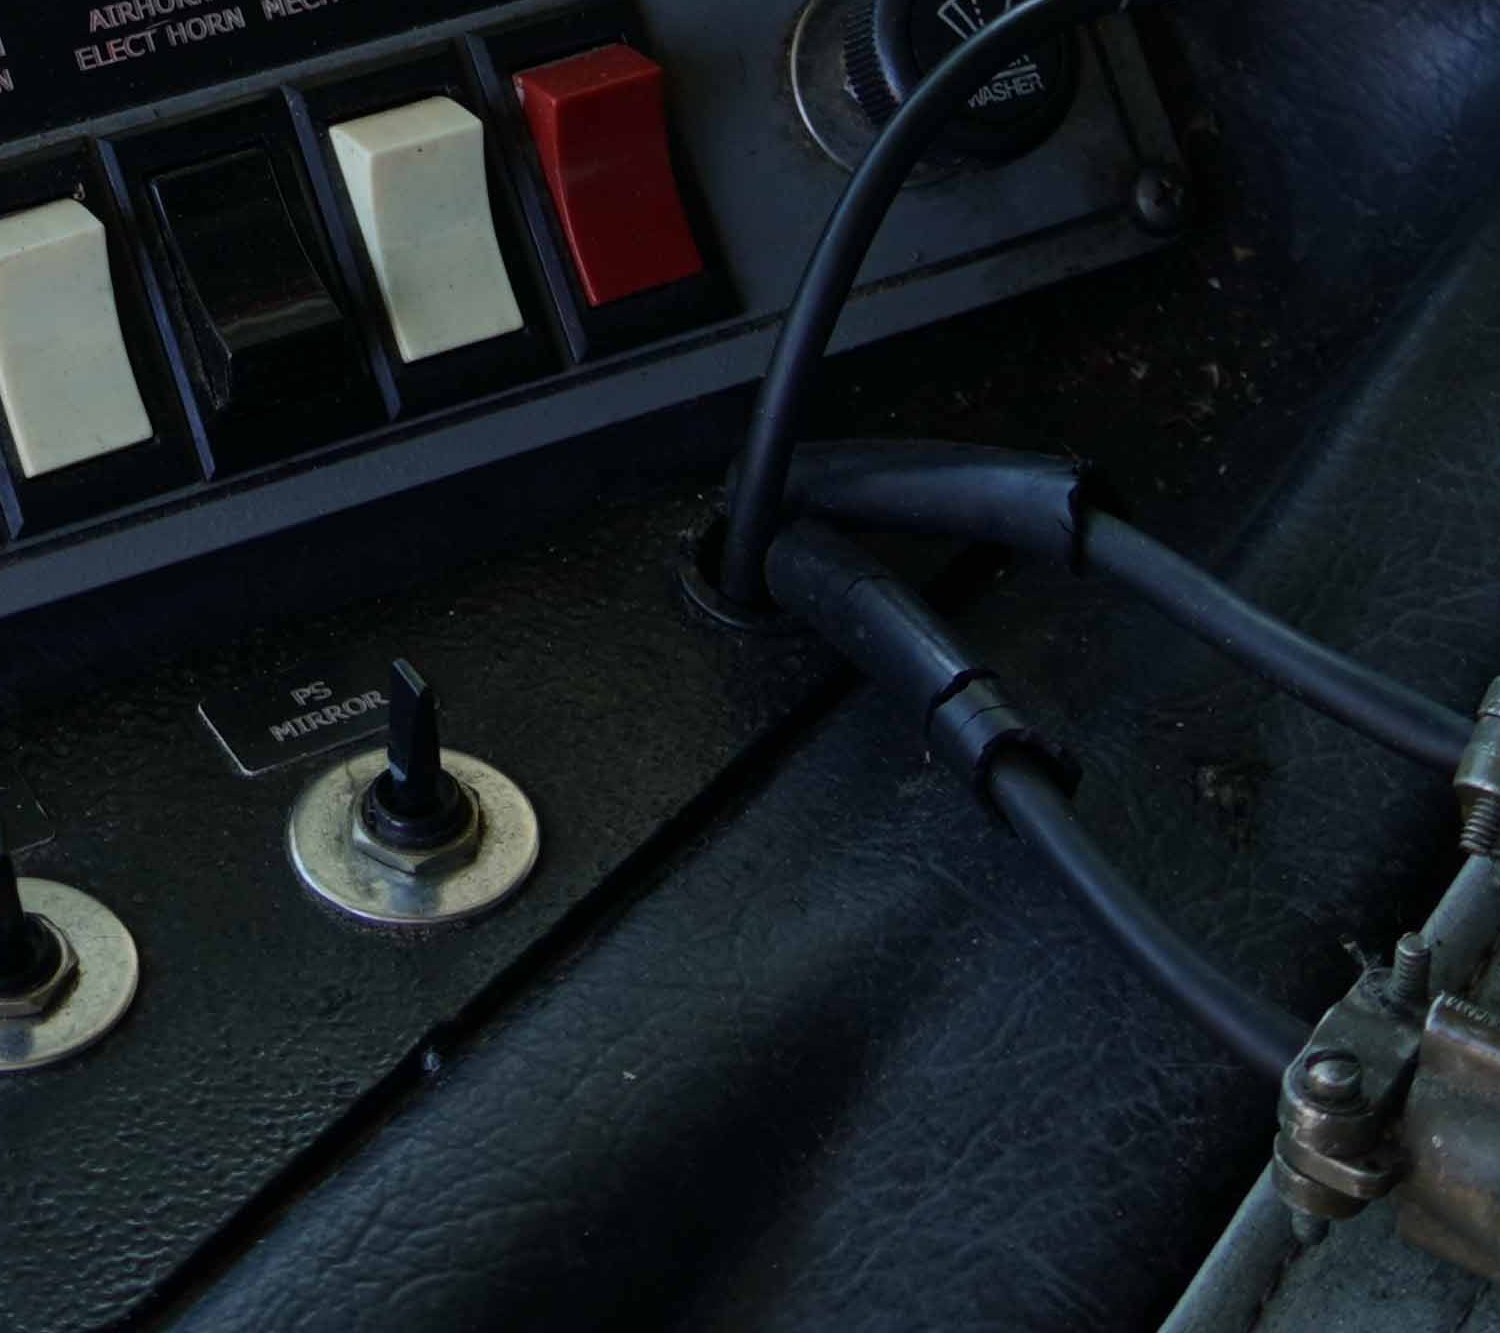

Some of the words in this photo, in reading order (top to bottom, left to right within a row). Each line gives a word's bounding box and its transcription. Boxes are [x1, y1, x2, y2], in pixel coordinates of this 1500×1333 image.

[73, 27, 160, 73] ELECT
[166, 6, 247, 48] HORN
[967, 71, 1046, 109] WASHER
[266, 688, 392, 743] MIRROR
[289, 679, 334, 708] PS
